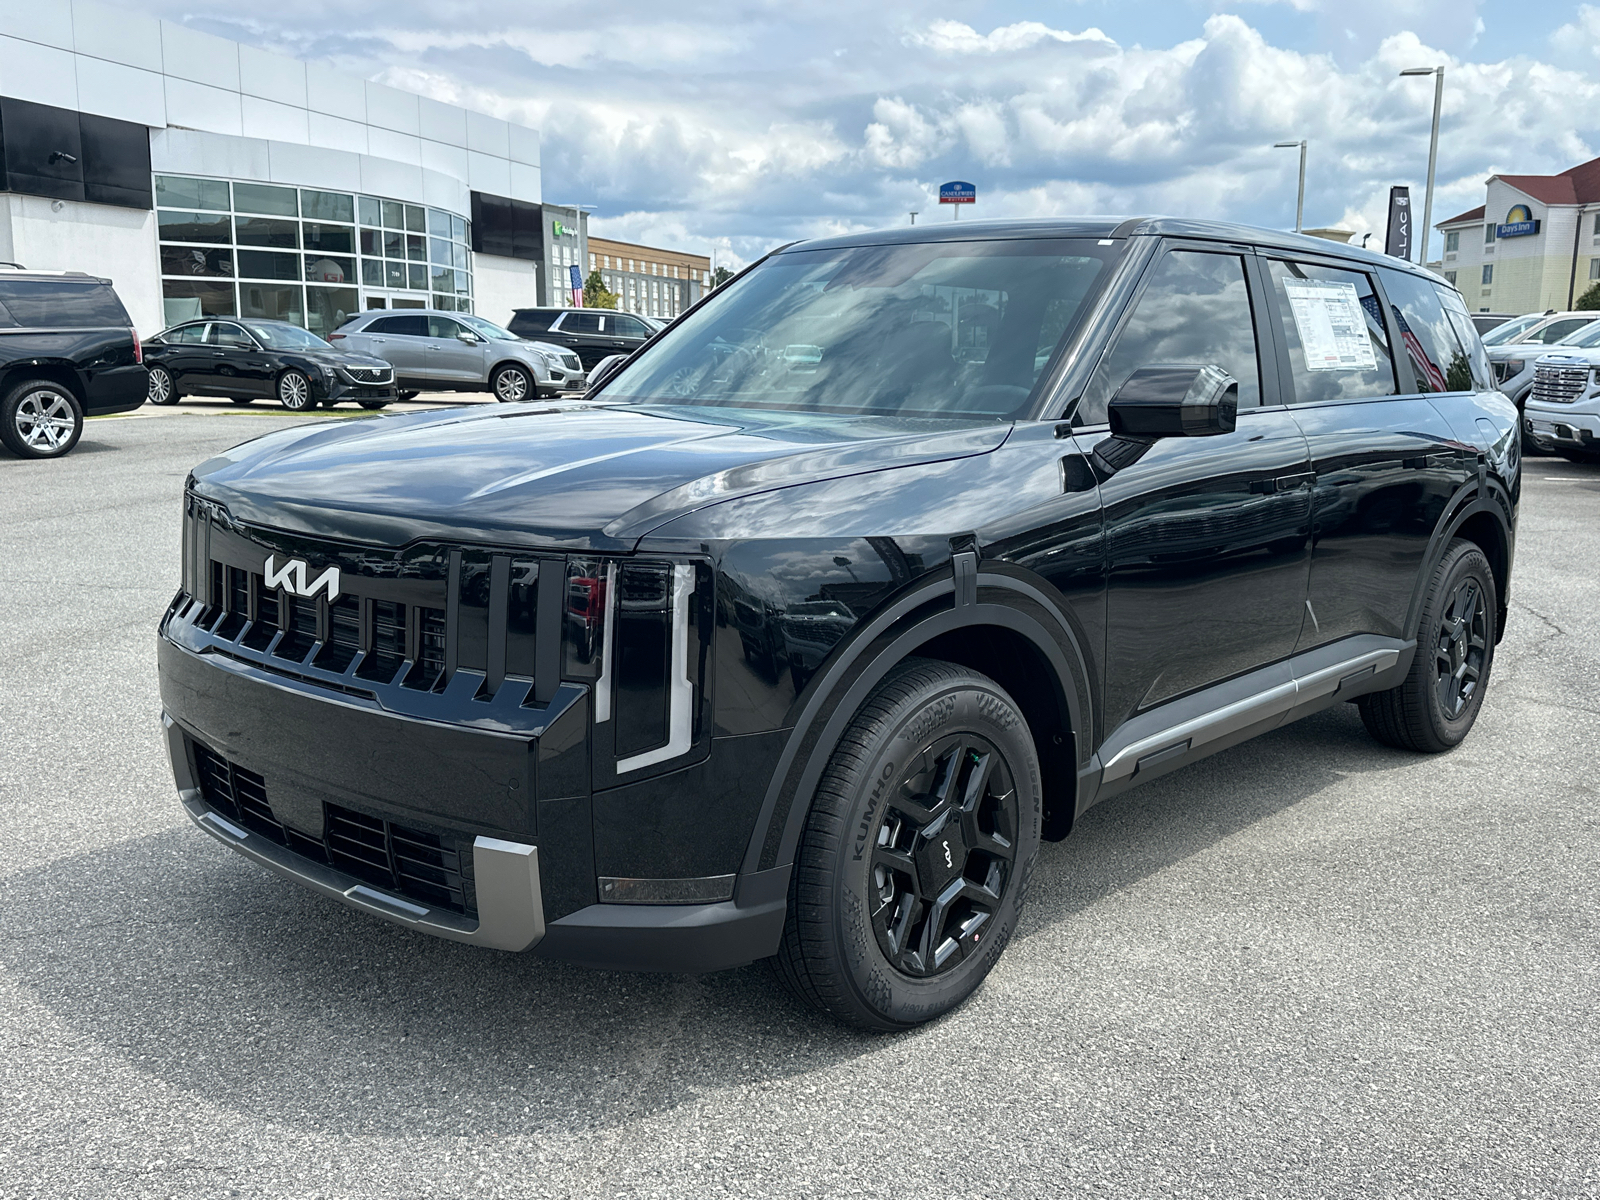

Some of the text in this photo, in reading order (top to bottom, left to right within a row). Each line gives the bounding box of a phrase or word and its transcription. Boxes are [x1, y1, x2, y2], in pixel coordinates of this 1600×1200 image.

[1501, 225, 1518, 234] Days
[1518, 223, 1530, 231] Inn
[264, 554, 340, 602] KIA
[853, 761, 895, 860] KUMHO
